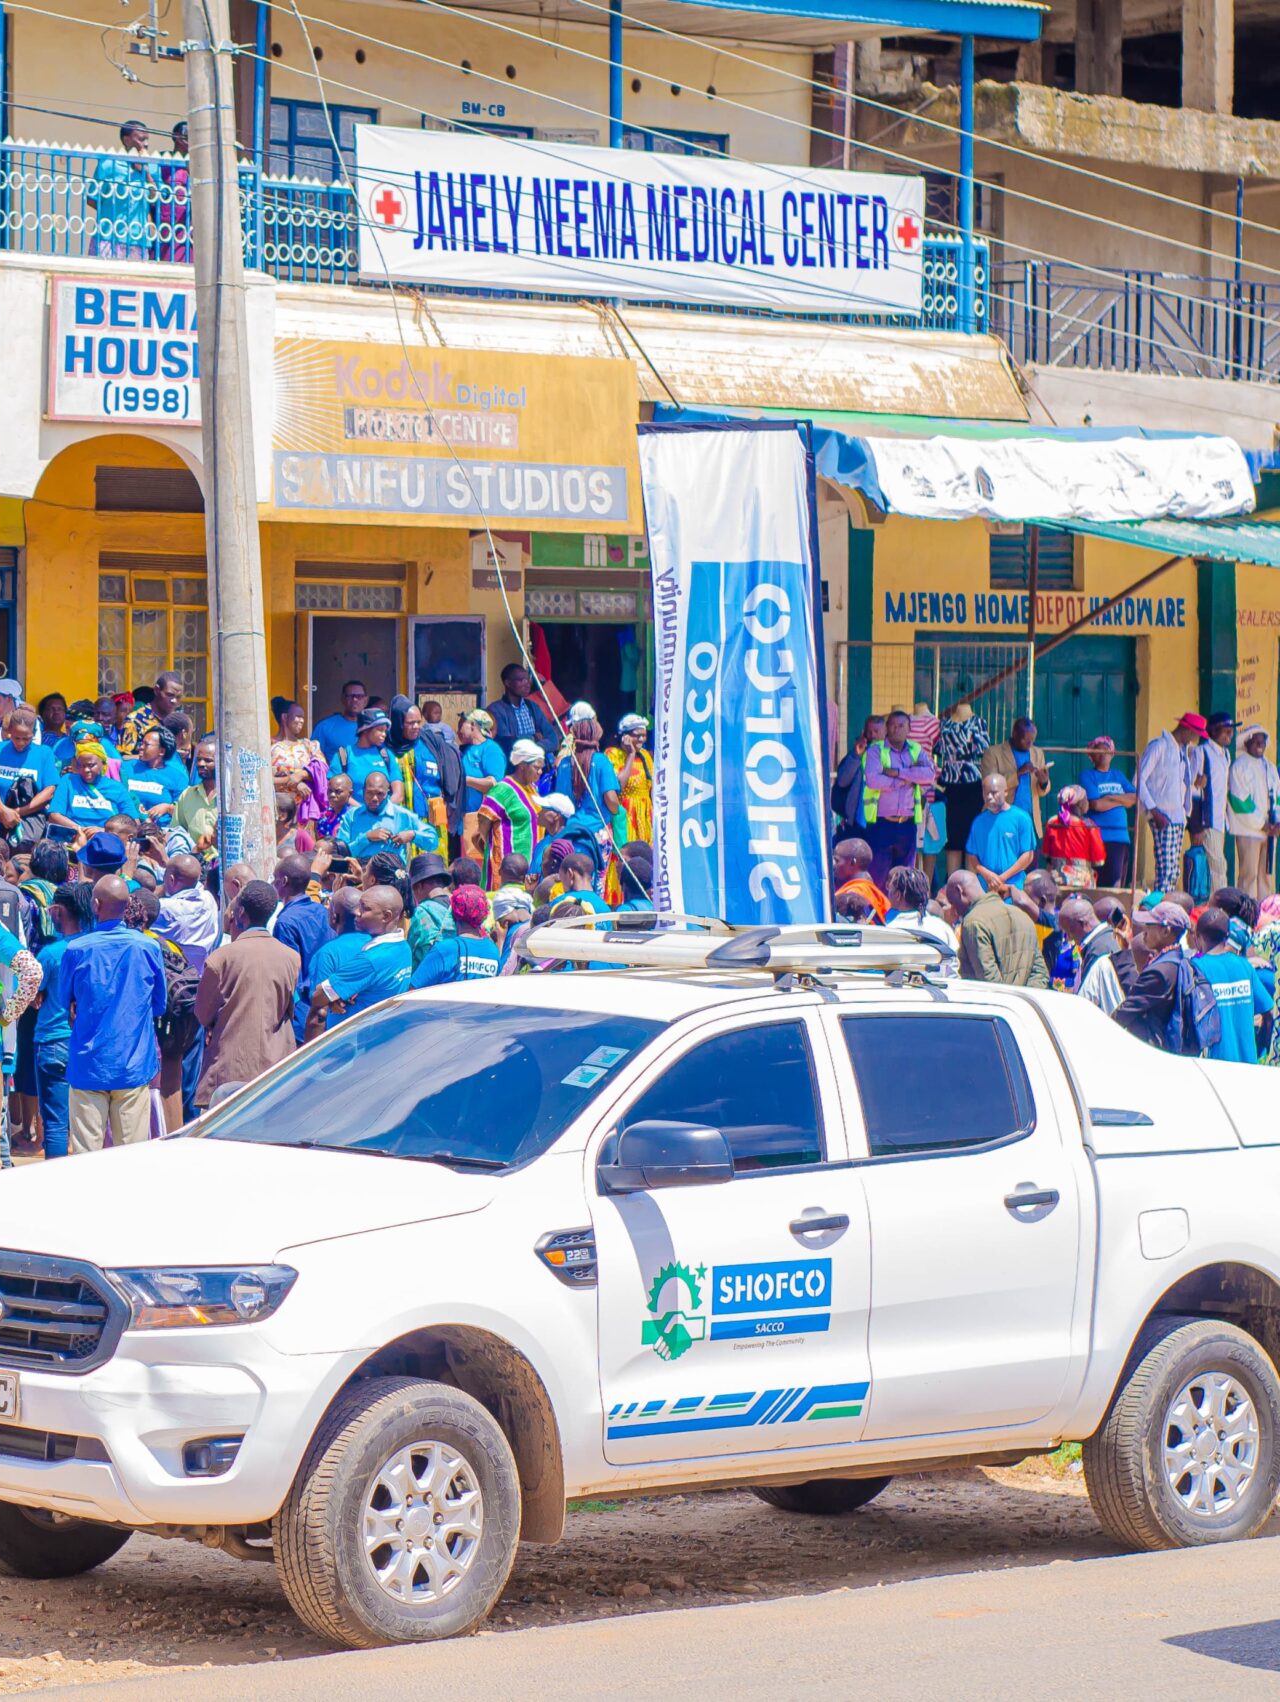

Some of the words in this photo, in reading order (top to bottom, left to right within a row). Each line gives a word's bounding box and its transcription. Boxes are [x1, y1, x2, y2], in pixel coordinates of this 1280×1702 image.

[413, 170, 522, 255] JAHELY
[532, 177, 638, 261] NEEMA
[647, 184, 775, 267] MEDICAL
[782, 191, 890, 271] CENTER
[103, 380, 189, 419] (1998)
[334, 354, 457, 403] Kodak
[457, 384, 528, 411] Digital
[446, 465, 614, 515] STUDIOS
[885, 591, 968, 624] MJENGO
[975, 594, 1030, 625] HOME
[1035, 595, 1087, 625] DEPOT
[1089, 597, 1186, 628] HARDWARE
[719, 1269, 826, 1304] SHOFCO
[733, 1341, 765, 1350] Empowering
[765, 1339, 775, 1347] The
[775, 1337, 805, 1346] Community
[755, 1321, 785, 1334] SACCO
